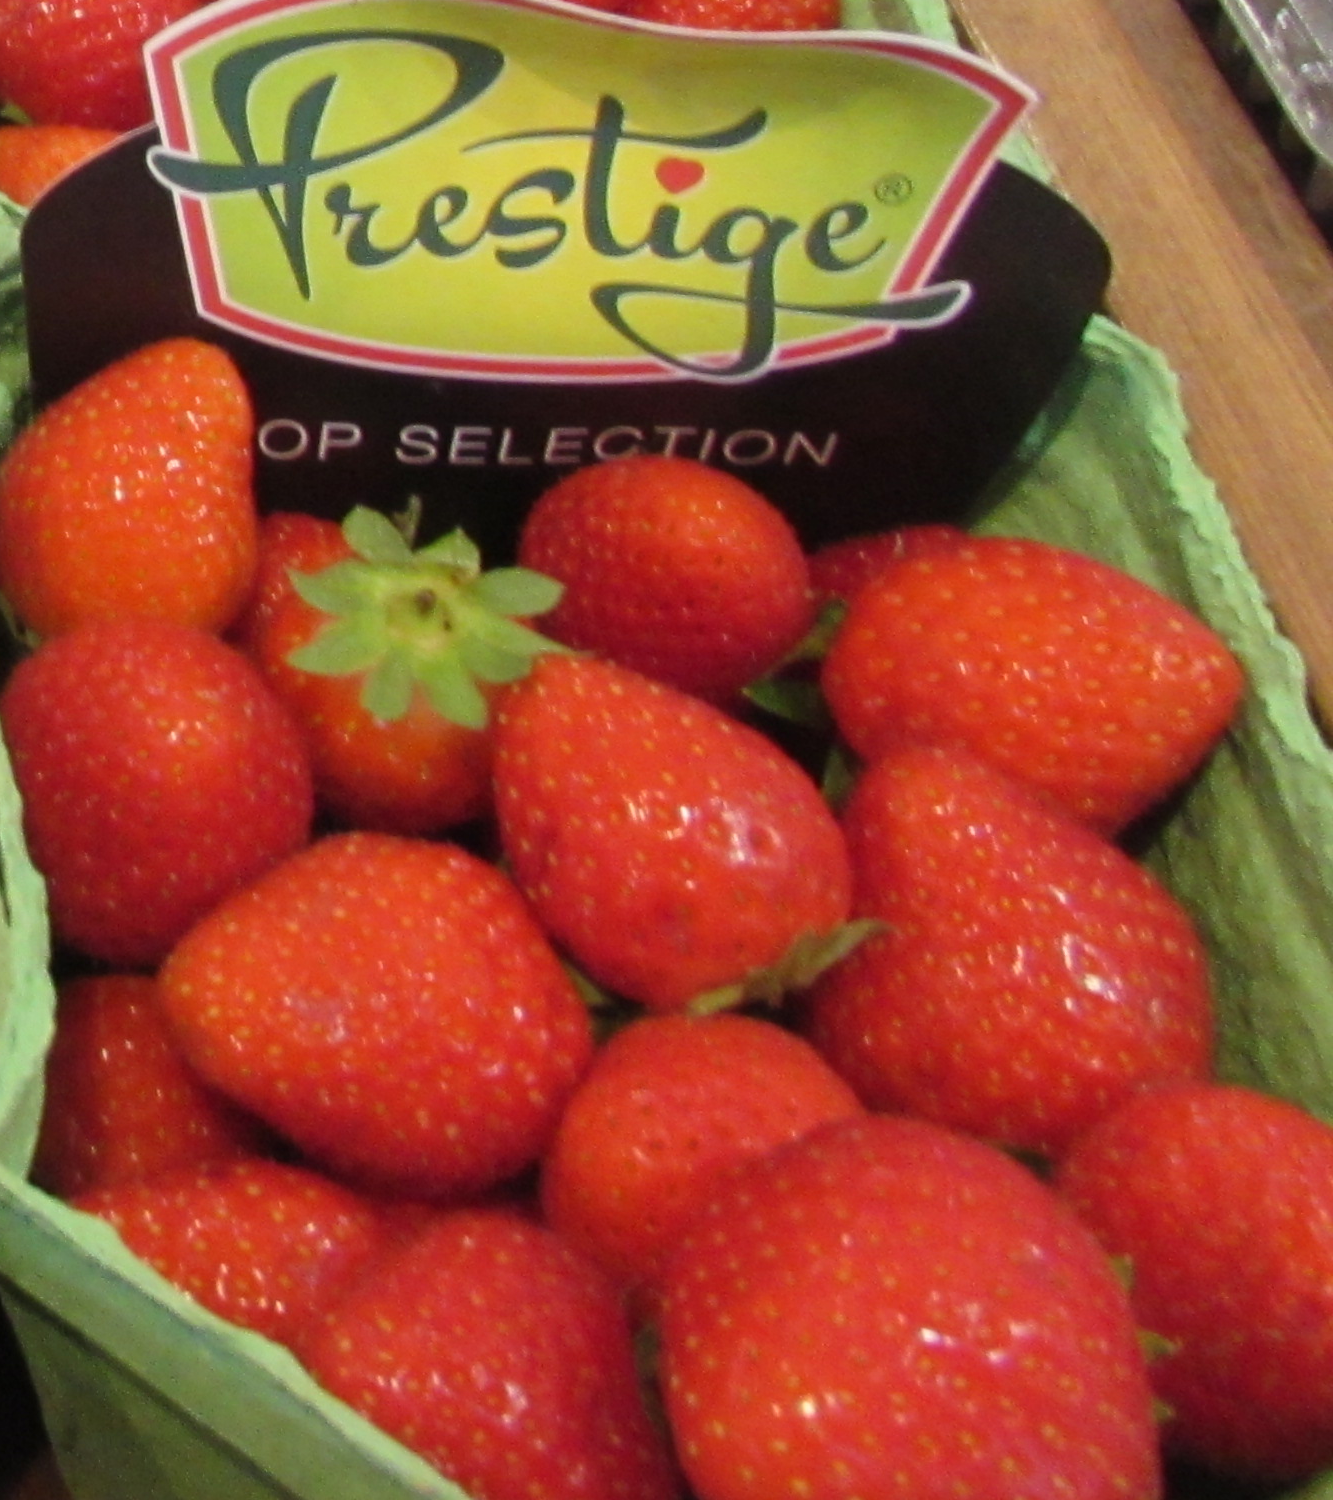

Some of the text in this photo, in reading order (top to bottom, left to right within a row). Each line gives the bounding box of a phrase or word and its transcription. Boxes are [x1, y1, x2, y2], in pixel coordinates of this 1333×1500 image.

[150, 29, 968, 376] Prestige
[257, 418, 839, 468] OP SELECTION
